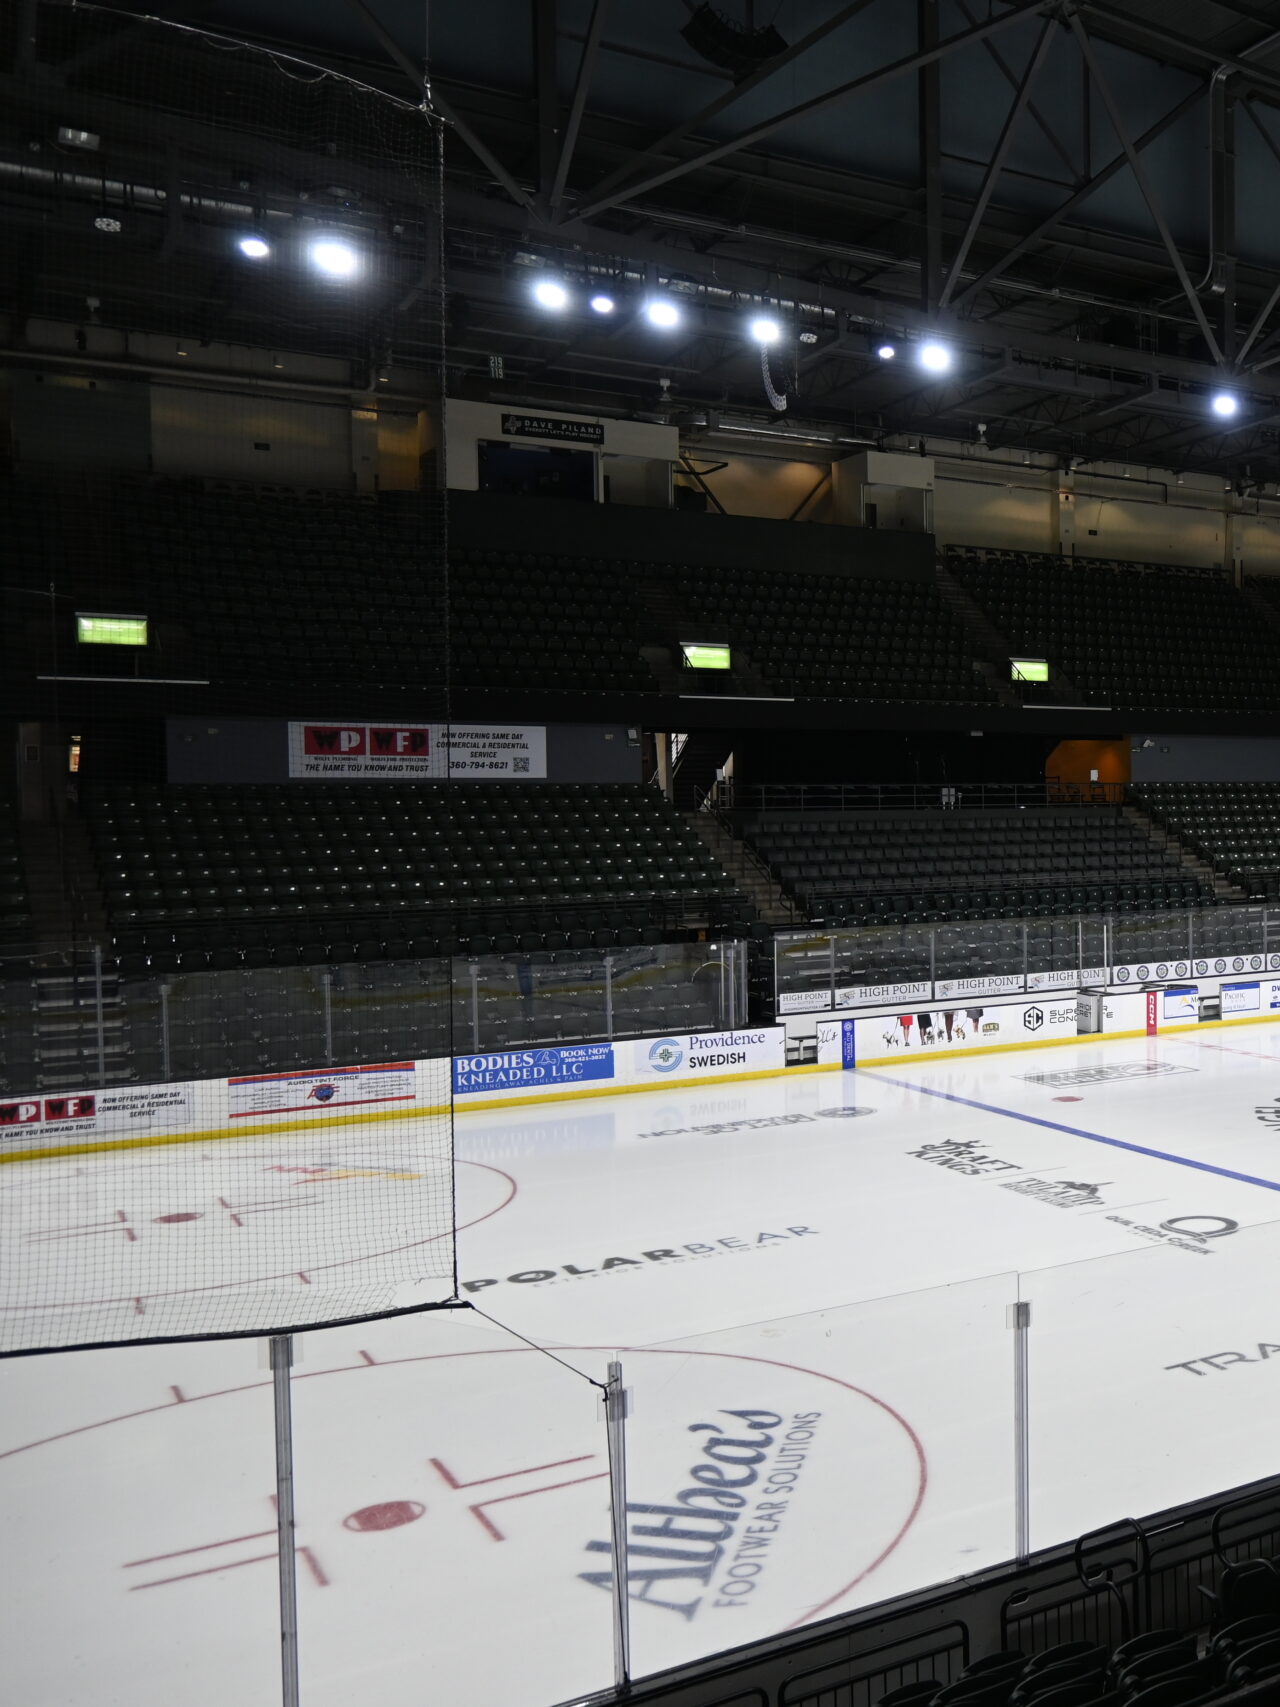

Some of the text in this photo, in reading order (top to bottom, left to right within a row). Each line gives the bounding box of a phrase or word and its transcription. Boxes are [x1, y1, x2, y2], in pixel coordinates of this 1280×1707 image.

[524, 419, 602, 434] DAVE PILAND
[375, 731, 424, 752] WFP
[458, 732, 490, 740] OFFERING
[436, 741, 480, 749] COMMERCIAL
[488, 741, 529, 750] RESIDENTIAL
[470, 751, 498, 759] SERVICE
[305, 764, 430, 773] THE NAME YOU KNOW AND TRUST
[450, 761, 509, 770] 360-794-8621
[957, 976, 1021, 990] HIGH POINT
[1048, 971, 1074, 982] HIGH
[782, 992, 829, 1001] HIGH POINT
[859, 983, 928, 998] HIGH POINT
[1224, 992, 1246, 1000] PACIFIC
[1147, 994, 1155, 1025] CCM
[688, 1032, 766, 1051] Providence
[560, 1047, 610, 1058] BOOK NOW
[457, 1052, 535, 1074] BODIES
[689, 1052, 746, 1069] SWEDISH
[287, 1078, 314, 1086] AUDIO
[333, 1074, 360, 1082] FORCE
[457, 1063, 584, 1087] KNEADED LLC
[504, 1080, 525, 1088] AWAY
[528, 1077, 554, 1085] ACHES
[97, 1103, 140, 1113] COMMERCIAL
[147, 1098, 186, 1108] RESIDENTIAL
[102, 1096, 118, 1104] NOW
[118, 1094, 149, 1102] OFFERING
[51, 1099, 93, 1116] WFP
[129, 1109, 156, 1118] SERVICE
[5, 1129, 24, 1138] NAME
[25, 1128, 39, 1136] YOU
[40, 1126, 61, 1135] KNOW
[60, 1125, 74, 1133] AND
[75, 1123, 96, 1132] TRUST
[905, 1149, 991, 1176] KINGS
[920, 1143, 1024, 1171] DRAFT
[1133, 1225, 1169, 1238] CEDA
[712, 1411, 822, 1608] FOOTWEAR SOLUTIONS
